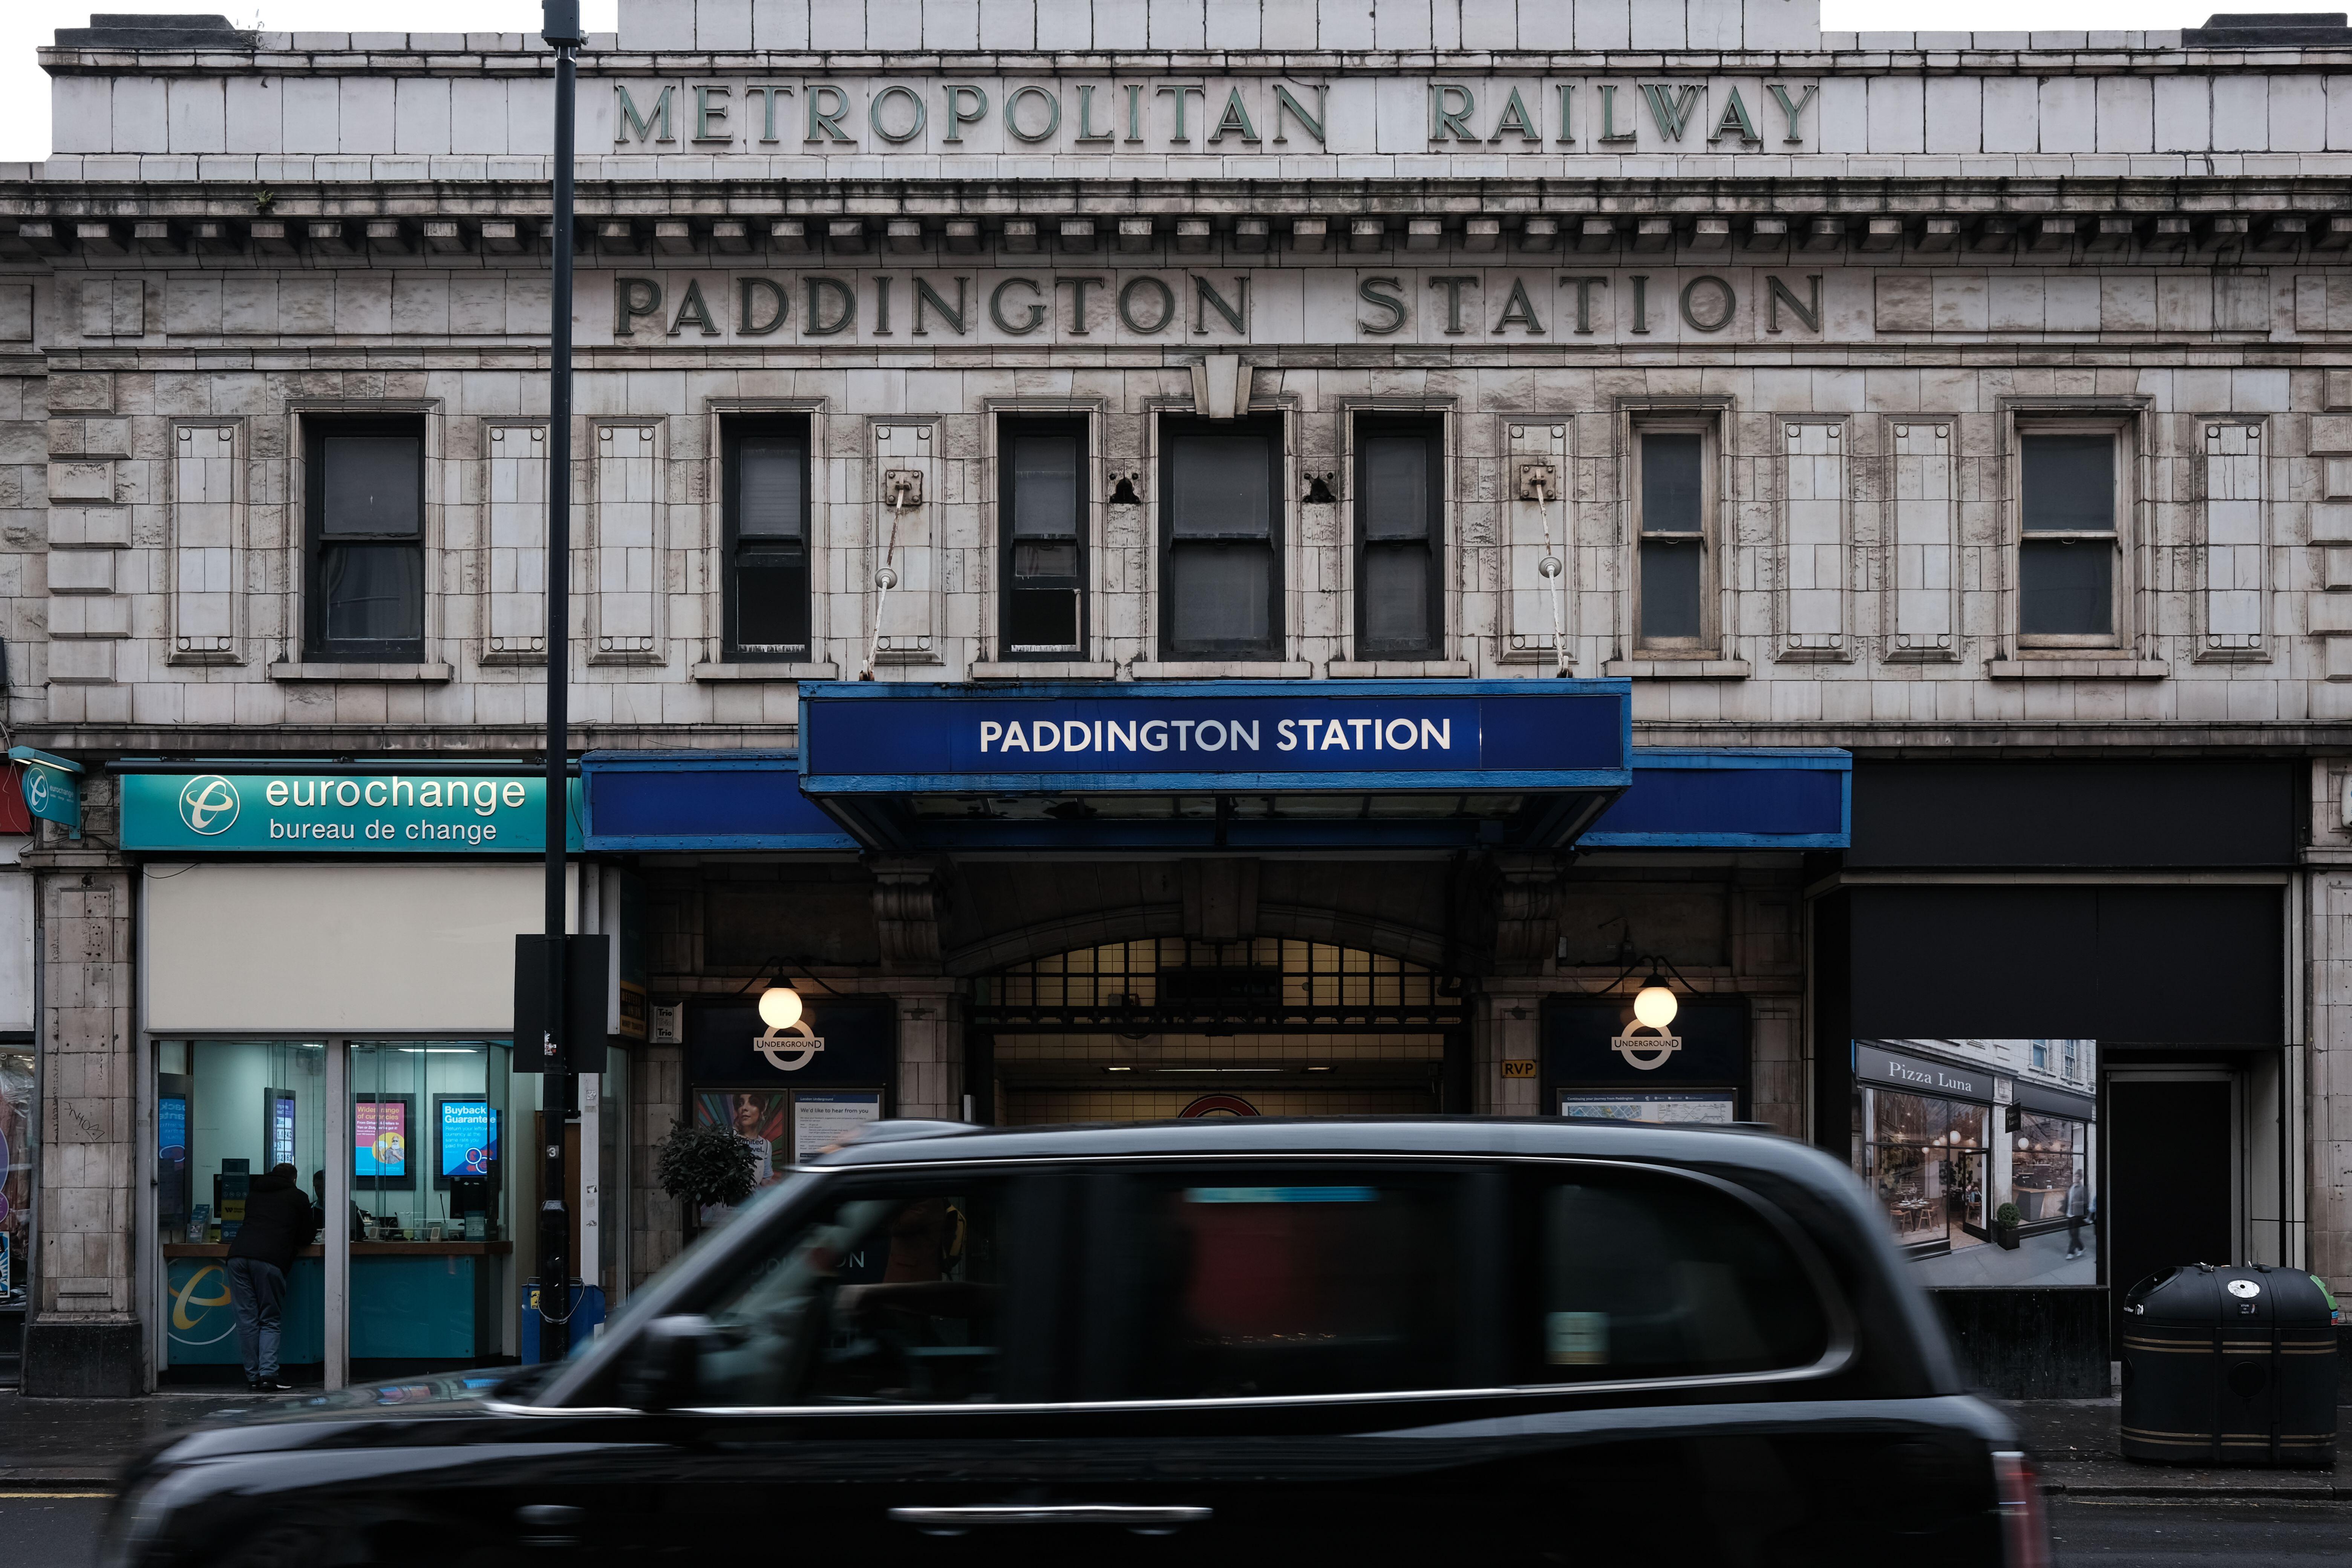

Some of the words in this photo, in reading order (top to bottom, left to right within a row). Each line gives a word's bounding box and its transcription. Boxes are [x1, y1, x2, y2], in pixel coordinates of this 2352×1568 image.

[614, 84, 1329, 144] METROPOLITAN
[1428, 83, 1819, 143] RAILWAY
[614, 276, 1250, 336] PADDINGTON
[1358, 274, 1823, 335] STATION
[980, 720, 1259, 752] PADDINGTON
[1277, 718, 1450, 750] STATION
[49, 785, 74, 798] eurochange
[266, 776, 525, 816] eurochange
[270, 819, 354, 839] bureau
[365, 819, 395, 839] de
[405, 819, 496, 845] change
[1614, 1039, 1679, 1047] UNDERGROUND
[1505, 1063, 1533, 1074] RVP
[1889, 1061, 1932, 1084] Pizza
[1938, 1072, 1972, 1092] Luna
[444, 1106, 486, 1116] Buyback
[444, 1115, 496, 1124] Guarantee
[549, 1147, 556, 1157] 3
